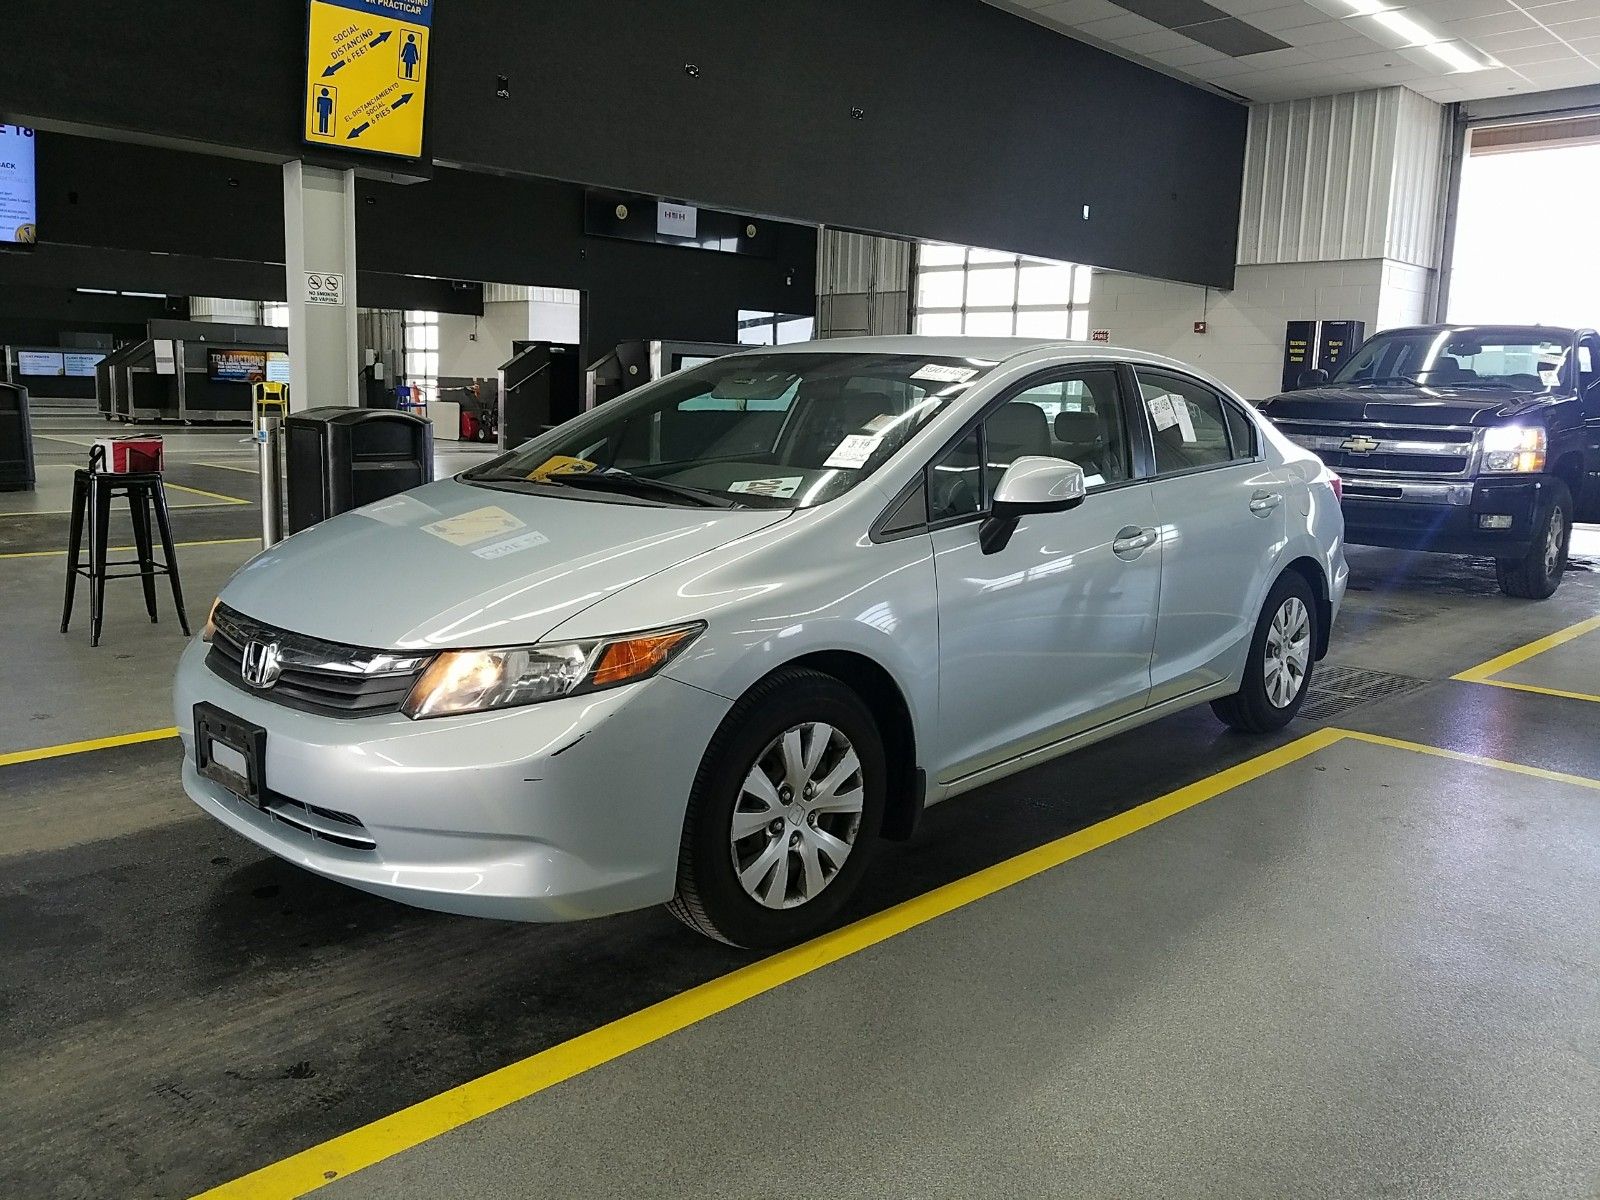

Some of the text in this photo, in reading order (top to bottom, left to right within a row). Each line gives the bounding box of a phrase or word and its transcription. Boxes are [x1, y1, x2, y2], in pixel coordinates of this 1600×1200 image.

[333, 24, 359, 43] SOCIAL
[331, 28, 373, 60] DISTANCING
[352, 45, 368, 60] FEET
[344, 82, 399, 122] EL DISTANCIAMIENTO
[366, 101, 385, 116] SOCIAL
[371, 108, 391, 124] 6 PIES
[228, 354, 265, 363] AUCTIONS
